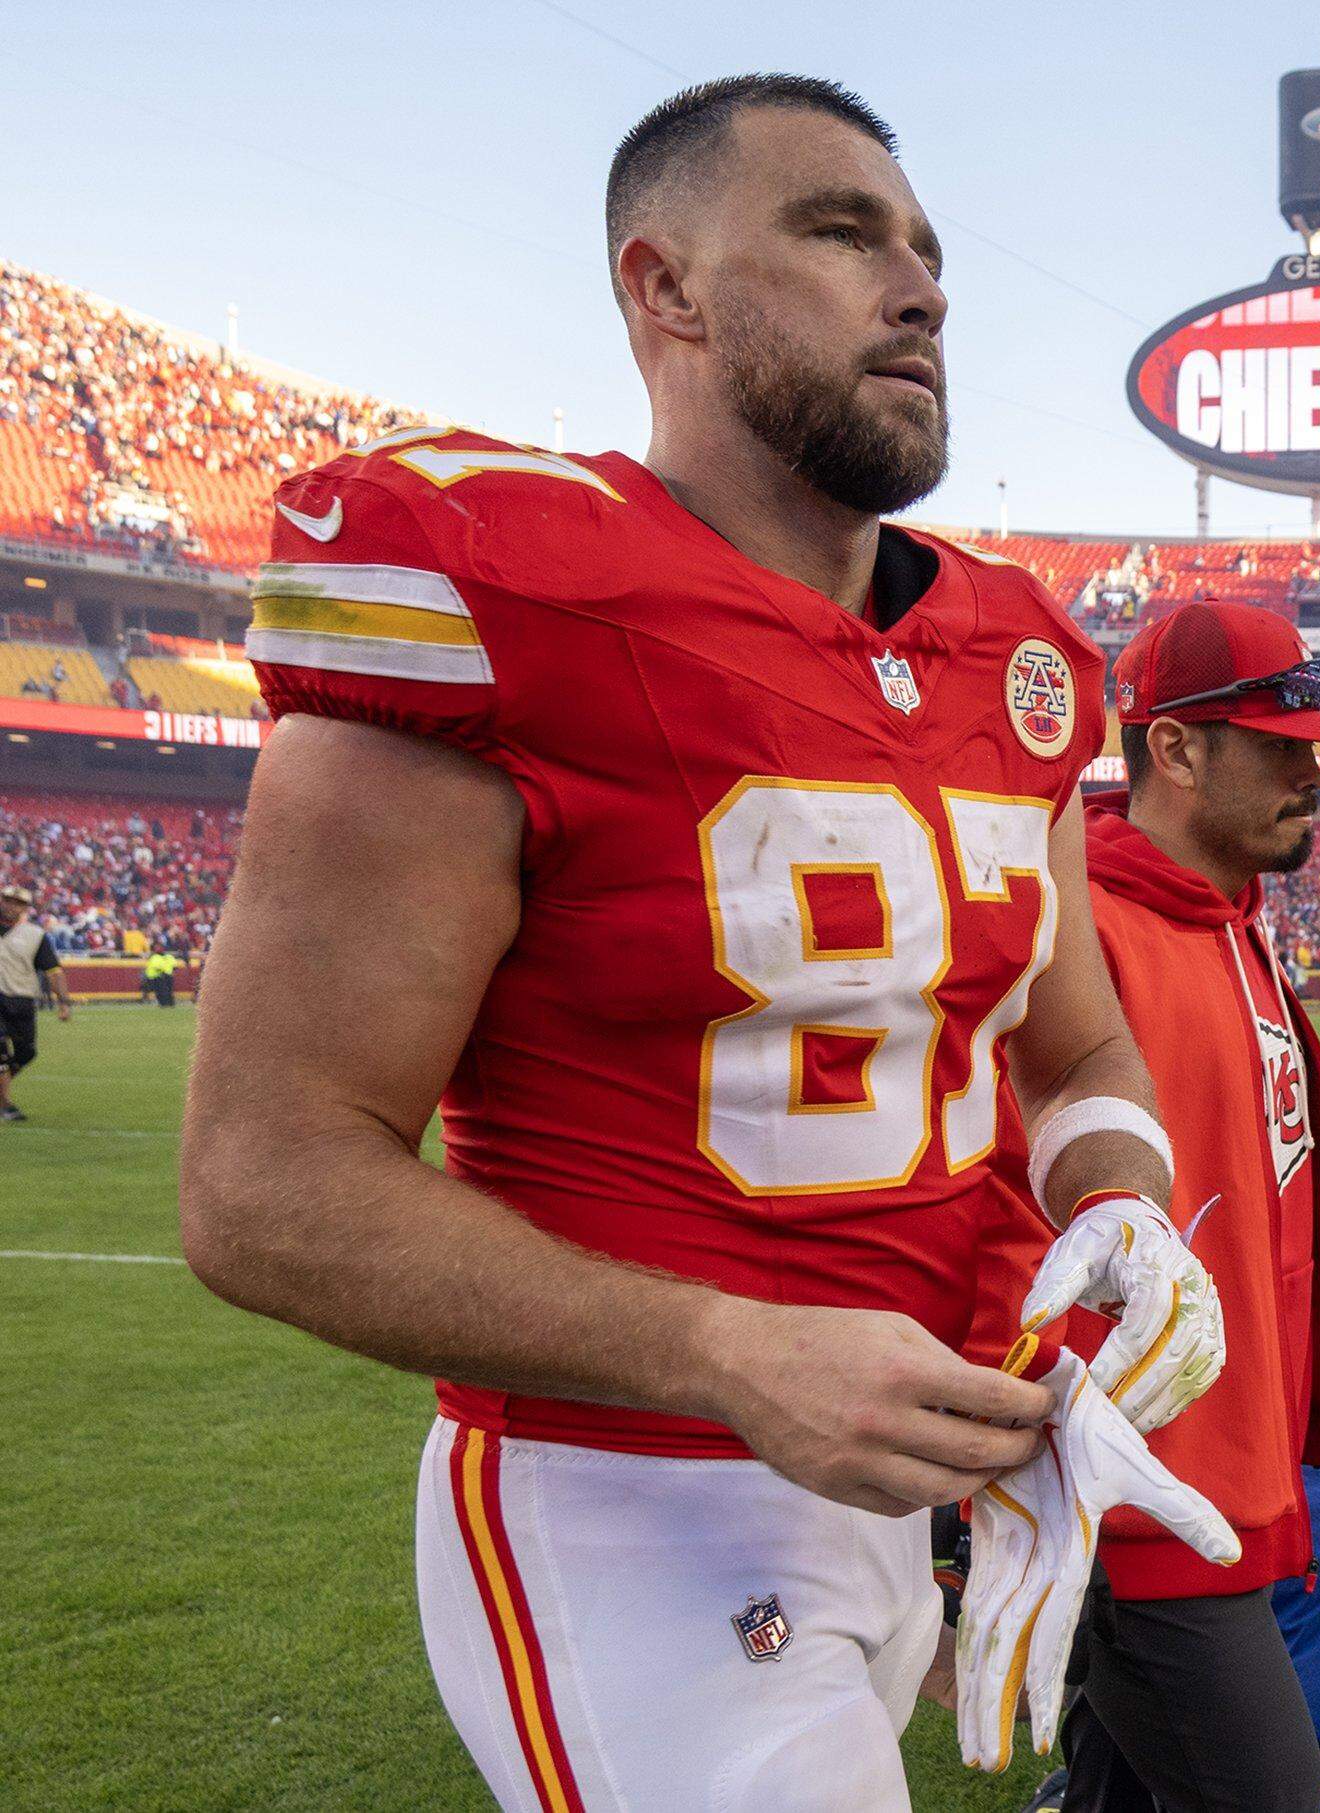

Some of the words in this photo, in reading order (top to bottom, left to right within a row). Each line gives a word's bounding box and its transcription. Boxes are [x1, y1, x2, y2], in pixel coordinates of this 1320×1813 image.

[1014, 650, 1067, 716] A
[697, 774, 1058, 1197] 87
[749, 1618, 787, 1653] NFL
